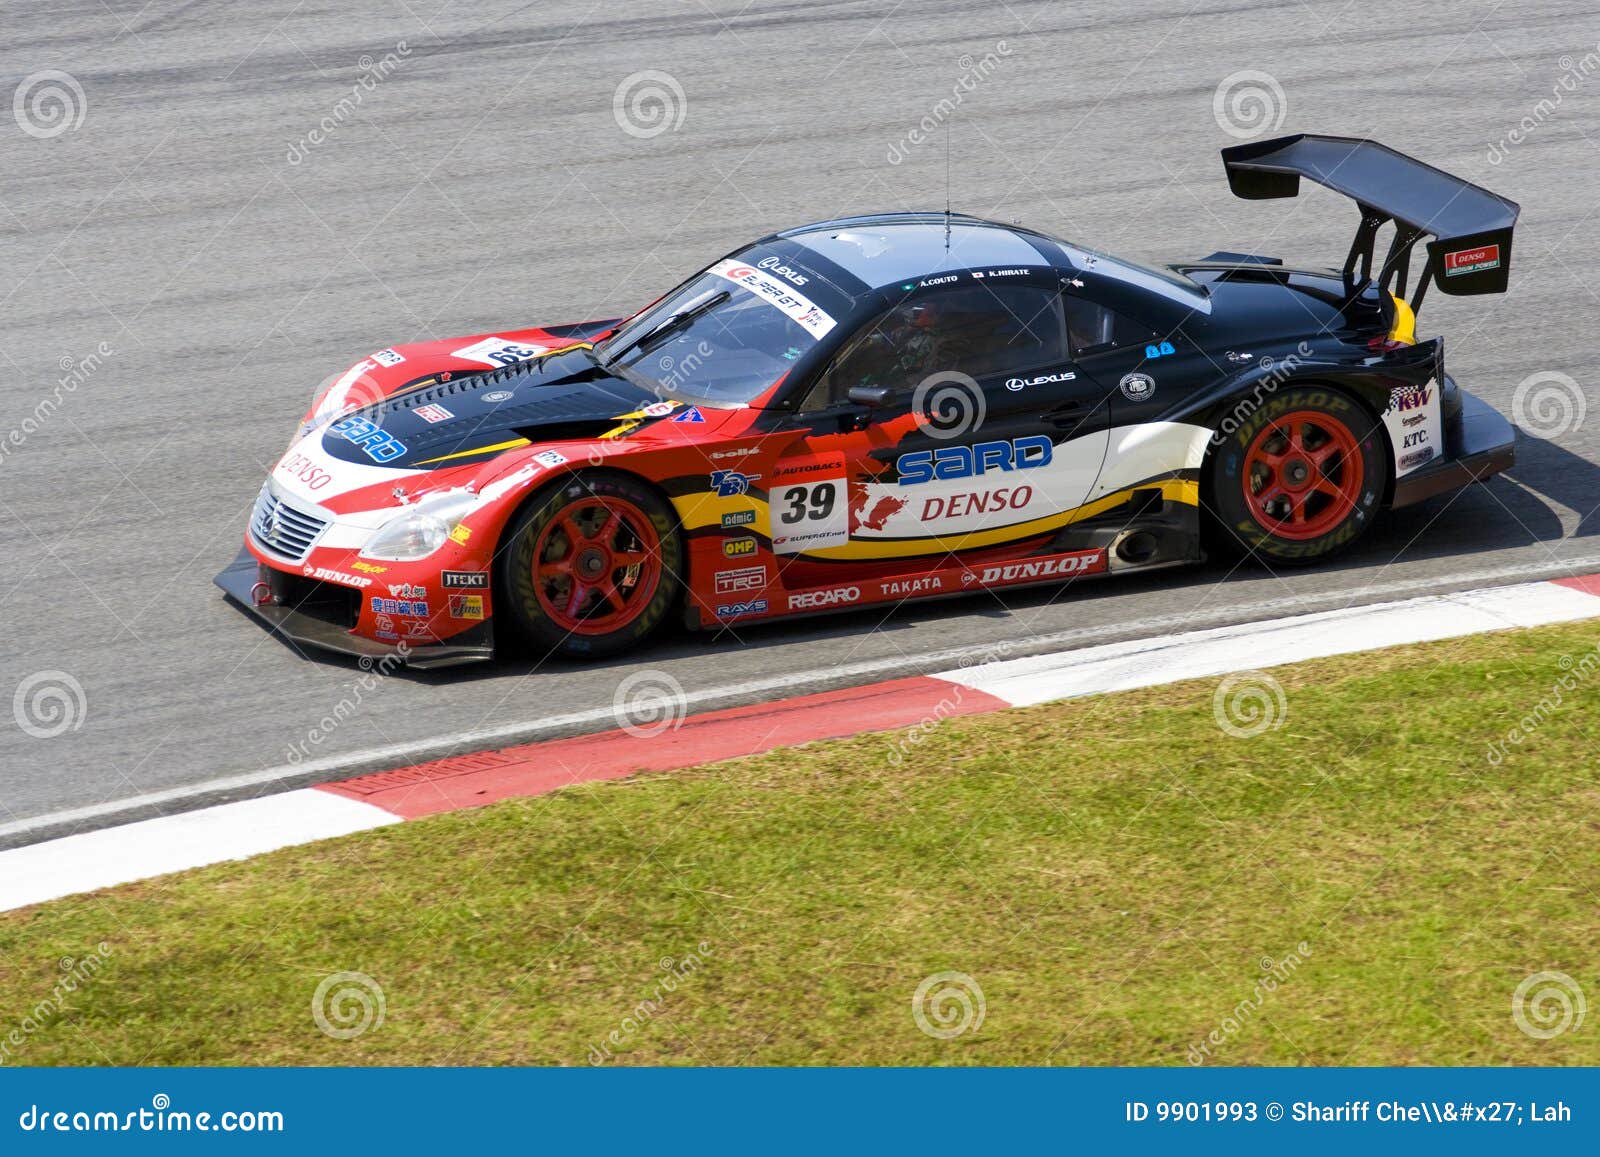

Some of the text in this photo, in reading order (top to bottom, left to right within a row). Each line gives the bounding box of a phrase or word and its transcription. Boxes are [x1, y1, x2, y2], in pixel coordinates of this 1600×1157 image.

[1458, 252, 1485, 263] DENSO
[774, 263, 809, 286] LEXUS
[920, 275, 958, 287] A.COUTO
[742, 275, 803, 310] SUPER GT
[1023, 371, 1077, 387] LEXUS
[1403, 429, 1427, 449] KTC
[281, 453, 332, 491] DENSO
[781, 461, 842, 475] AUTOBACS
[781, 482, 836, 524] 39
[920, 485, 1033, 522] DENSO
[725, 540, 754, 554] OMP
[313, 567, 373, 588] DUNLOP
[979, 555, 1099, 584] DUNLOP
[446, 573, 486, 586] JTEKT
[718, 575, 763, 591] TRD
[880, 577, 942, 595] TAKATA
[718, 600, 767, 615] RAYS
[788, 586, 861, 610] RECARO
